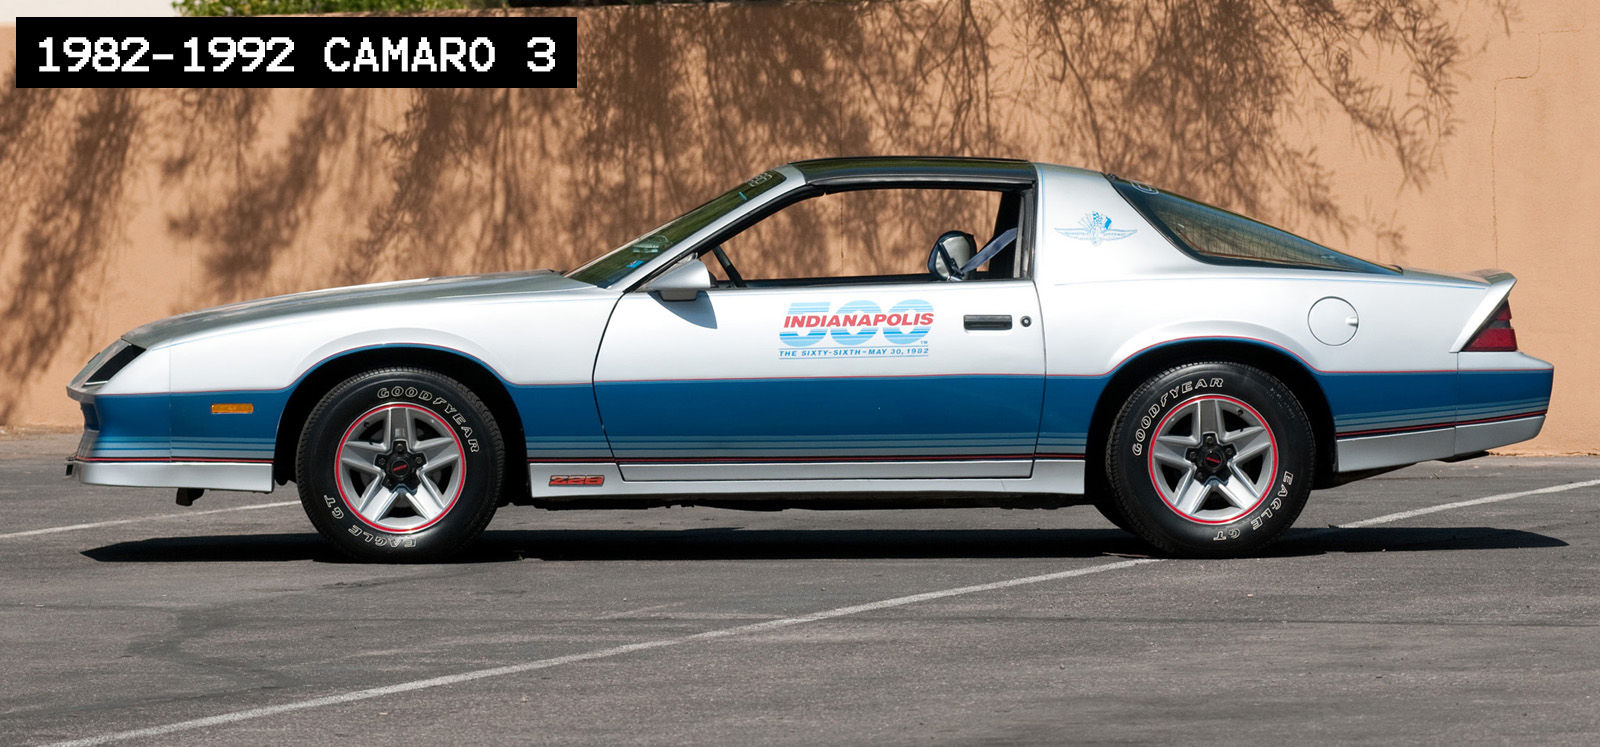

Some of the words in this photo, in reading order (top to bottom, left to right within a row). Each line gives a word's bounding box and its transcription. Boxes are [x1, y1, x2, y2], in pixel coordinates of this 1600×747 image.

[779, 299, 934, 347] 500
[783, 313, 934, 328] INDIANAPOLIS
[377, 386, 480, 453] GOODYEAR
[1132, 378, 1224, 456] GOODYEAR
[324, 495, 345, 520] GT
[1251, 471, 1294, 530] EAGLE
[348, 524, 417, 548] EAGLE
[1213, 528, 1240, 541] GT
